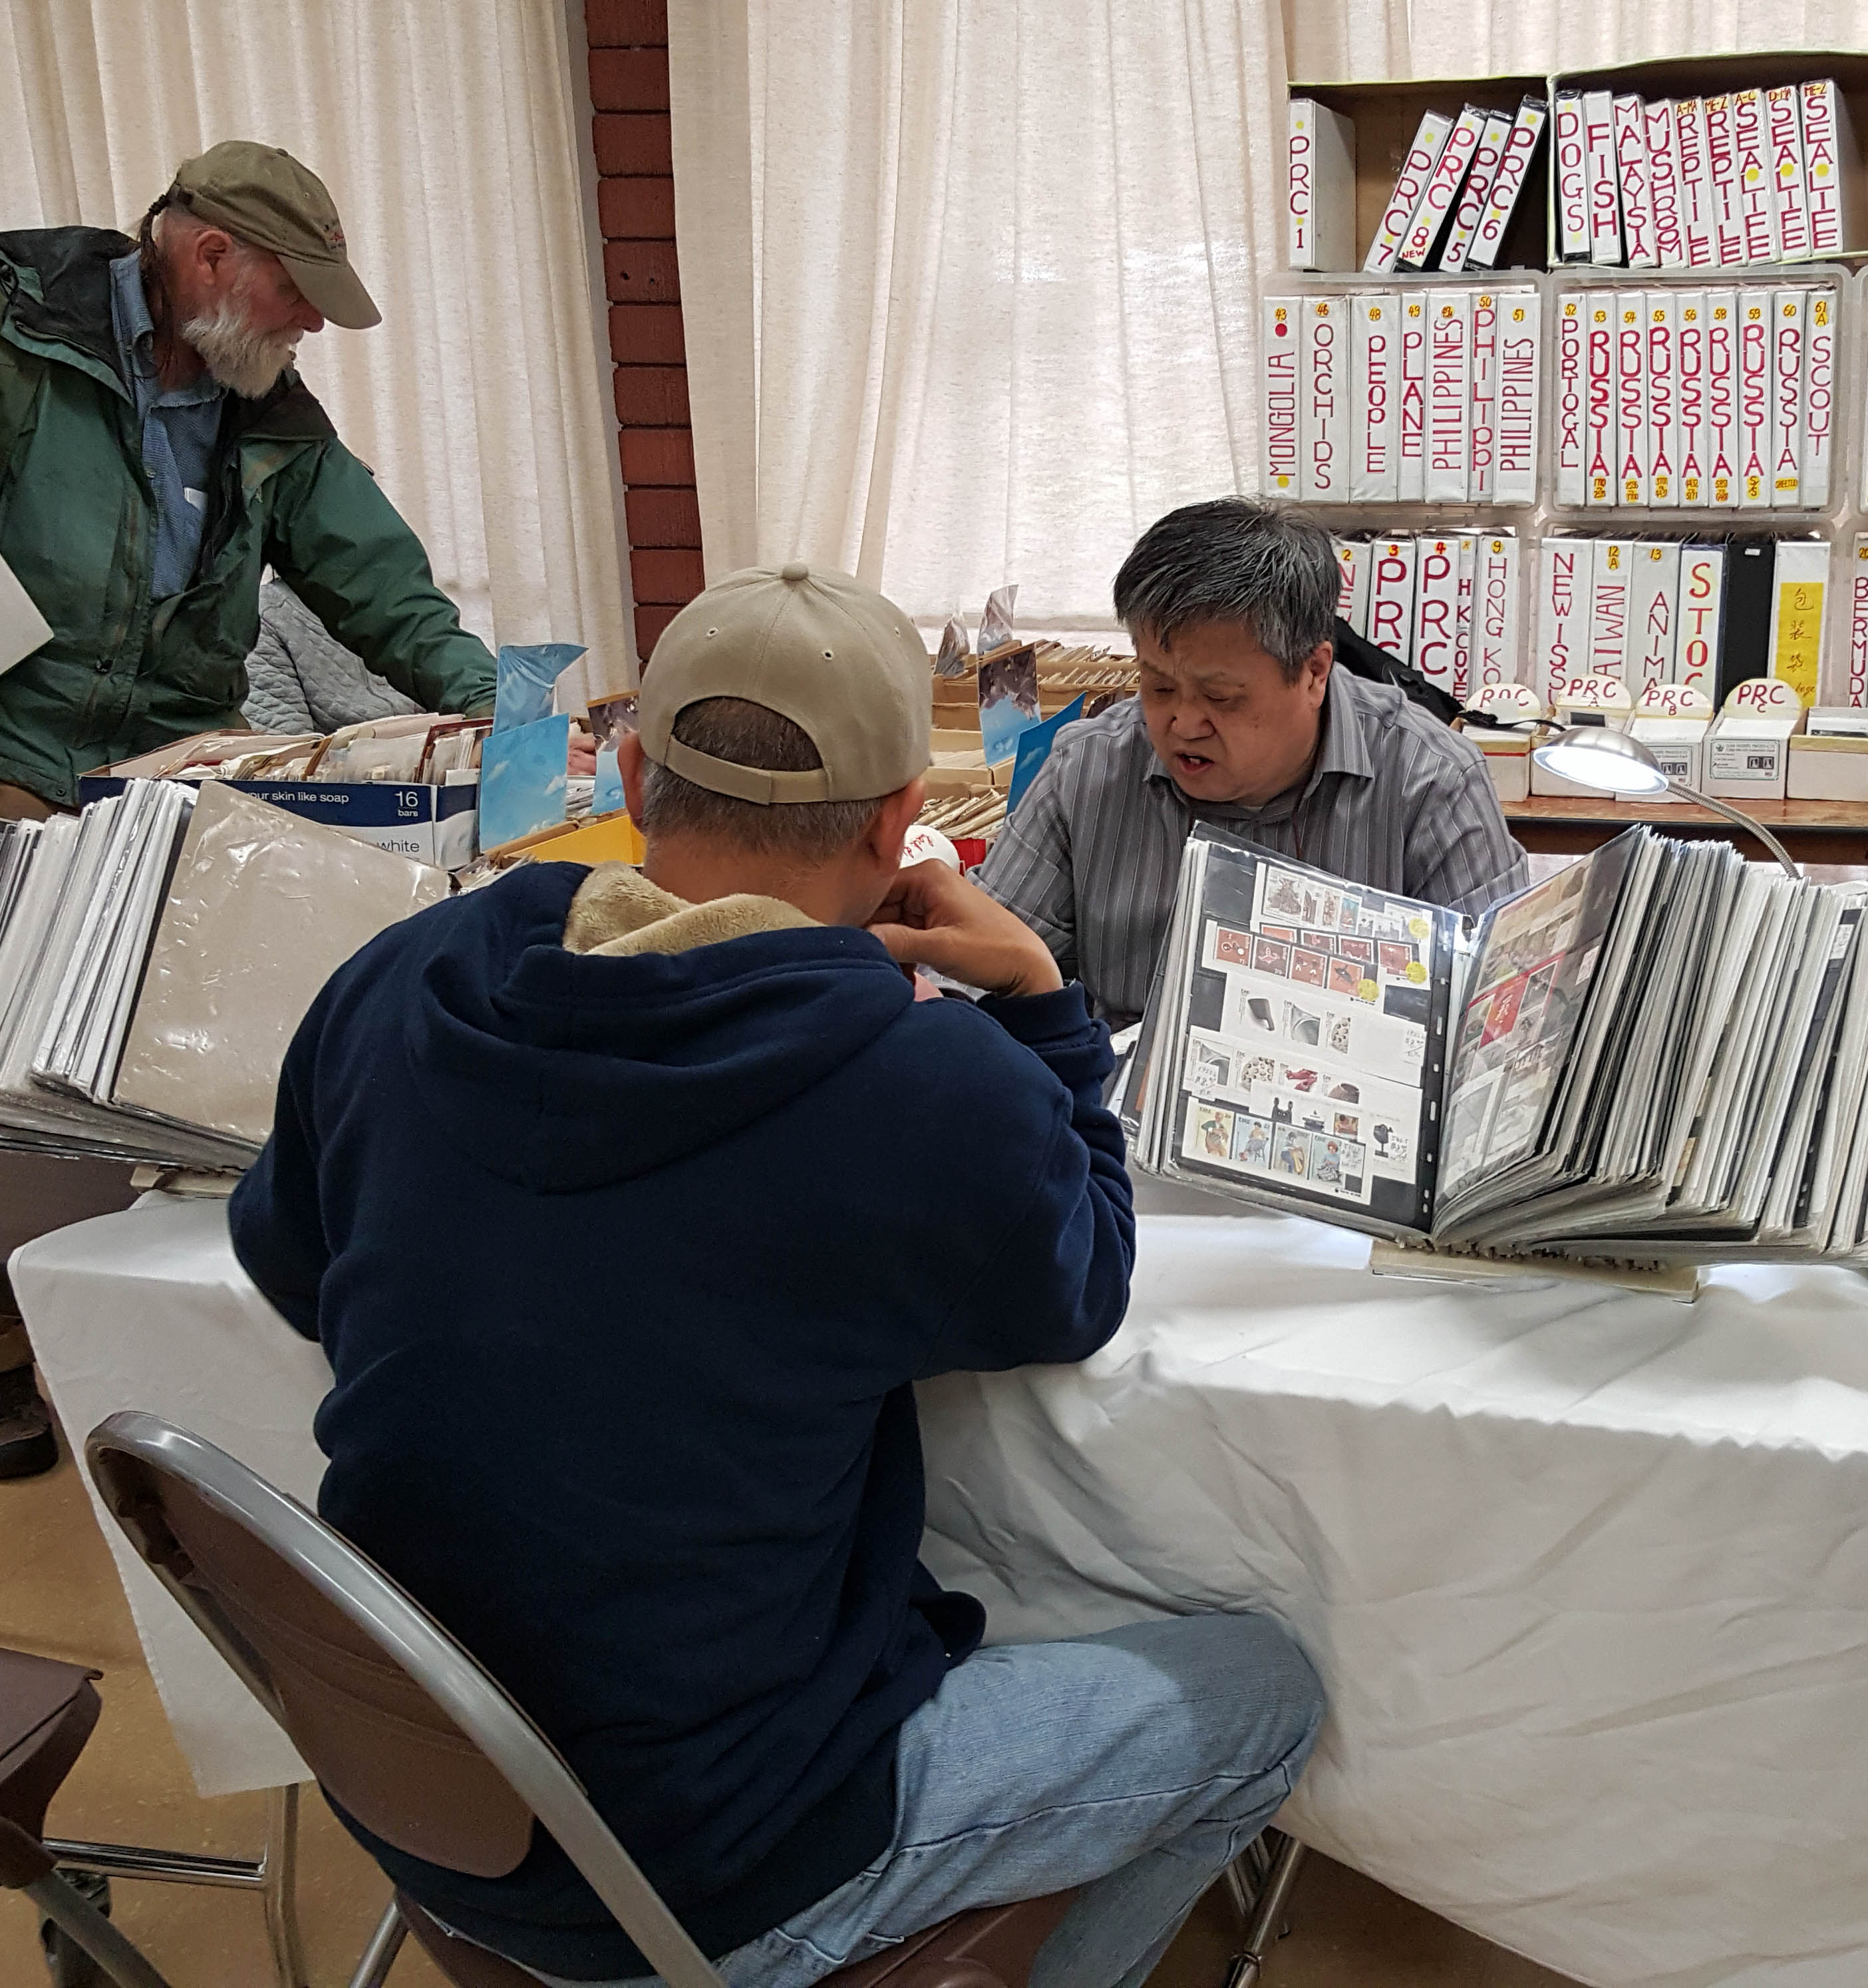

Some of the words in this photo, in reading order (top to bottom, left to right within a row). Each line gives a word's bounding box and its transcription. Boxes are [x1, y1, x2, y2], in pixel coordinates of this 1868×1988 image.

[1734, 90, 1757, 106] A-C
[1803, 84, 1827, 98] ME-Z
[1704, 96, 1728, 113] ME-Z
[1289, 136, 1310, 216] PRC
[1428, 127, 1475, 210] PRC
[1489, 127, 1535, 211] PRC
[1557, 112, 1585, 233] DOGS
[1456, 147, 1498, 231] PRC
[1587, 123, 1617, 238] FISH
[1614, 101, 1650, 261] MALAYSIA
[1645, 107, 1683, 266] MUSHROOM
[1676, 113, 1711, 266] REPTILE
[1706, 110, 1742, 265] REPTILE
[1384, 150, 1432, 237] PRC
[1296, 228, 1305, 249] 1
[1411, 226, 1430, 248] 8
[1482, 220, 1500, 240] 6
[1378, 244, 1394, 265] 7
[1401, 247, 1426, 260] NEW
[1446, 242, 1466, 263] 5
[1317, 303, 1329, 317] 46
[1408, 305, 1421, 318] 49
[1479, 295, 1492, 307] 50
[1565, 303, 1577, 316] 52
[1783, 304, 1796, 317] 60
[1815, 301, 1827, 313] 61
[1275, 308, 1287, 321] 43
[1368, 308, 1382, 321] 48
[1513, 308, 1525, 321] 51
[1595, 311, 1606, 323] 53
[1624, 311, 1636, 323] 54
[1653, 310, 1665, 322] 55
[1684, 309, 1696, 321] 56
[1714, 307, 1727, 320] 58
[1748, 308, 1761, 320] 59
[1815, 313, 1826, 325] A
[1366, 335, 1387, 473] PEOPLE
[1402, 331, 1424, 458] PLANE
[1432, 318, 1464, 470] PHILIPPINES
[1472, 309, 1496, 492] PHILIPPI
[1499, 337, 1535, 472] PHILIPPINES
[1589, 330, 1610, 477] RUSSIA
[1619, 329, 1642, 479] RUSSIA
[1649, 326, 1672, 476] RUSSIA
[1679, 328, 1702, 478] RUSSIA
[1709, 326, 1733, 478] RUSSIA
[1742, 324, 1765, 477] RUSSIA
[1776, 328, 1801, 472] RUSSIA
[1807, 336, 1831, 456] SCOUT
[1268, 351, 1296, 477] MONGOLIA
[1313, 323, 1334, 490] ORCHIDS
[1342, 549, 1351, 561] 2
[1389, 544, 1399, 557] 3
[1434, 542, 1446, 554] 4
[1493, 541, 1501, 553] 9
[1608, 546, 1619, 558] 12
[1649, 548, 1661, 560] 13
[1608, 558, 1619, 570] A
[1551, 552, 1575, 617] NEW
[1373, 558, 1407, 651] PR
[1485, 557, 1507, 639] HONG
[1420, 554, 1452, 675] PRC
[1786, 588, 1814, 672] 包装袋
[1849, 577, 1868, 708] BERMUDA
[1453, 632, 1469, 703] COVE
[1567, 678, 1617, 699] PRC
[1645, 690, 1694, 707] PRC
[1737, 684, 1786, 706] PRC
[1668, 705, 1677, 717] B
[1756, 703, 1766, 713] C
[249, 792, 267, 801] our
[271, 792, 295, 801] skin
[298, 792, 317, 802] like
[320, 794, 349, 804] soap
[394, 791, 419, 808] 16
[398, 808, 419, 817] bars
[377, 840, 419, 853] white
